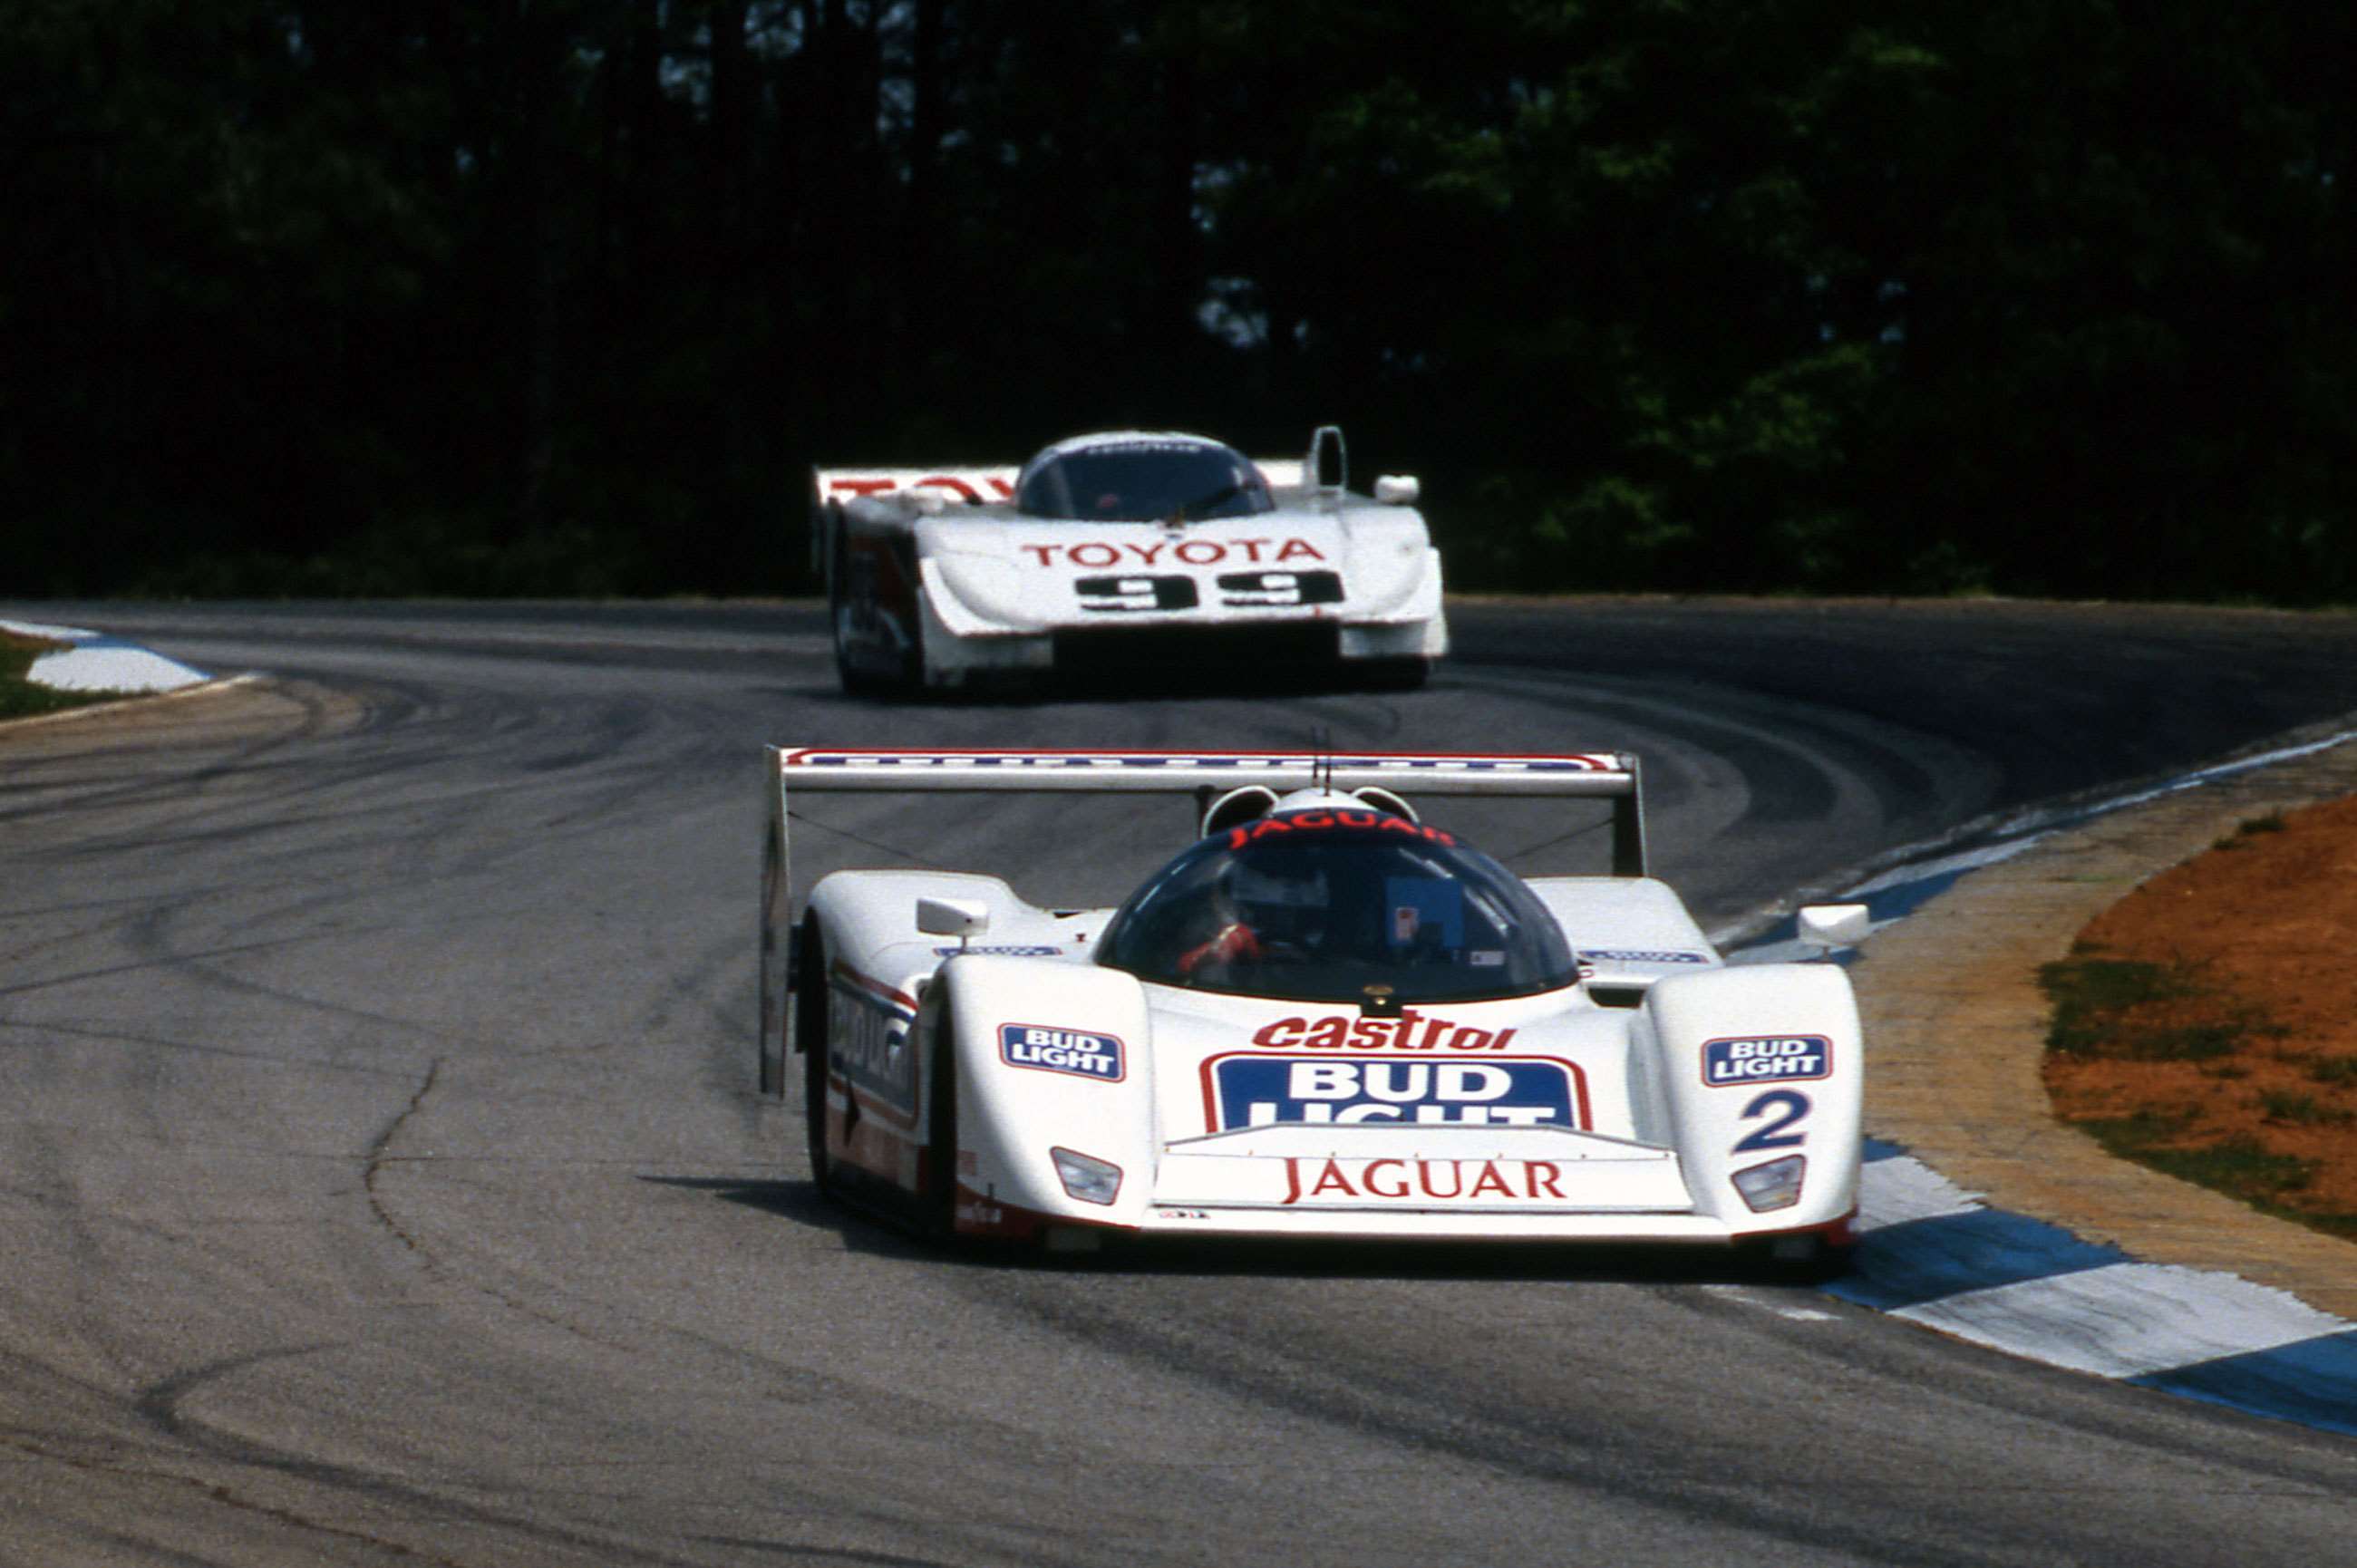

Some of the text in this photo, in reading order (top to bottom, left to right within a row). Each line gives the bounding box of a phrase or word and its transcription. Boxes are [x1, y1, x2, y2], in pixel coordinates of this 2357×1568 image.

[1021, 538, 1325, 567] TOYOTA
[1229, 810, 1455, 849] JAGUAR
[1025, 1029, 1101, 1053] BUD
[1730, 1040, 1808, 1060] BUD
[1012, 1042, 1115, 1073] LIGHT
[1713, 1055, 1821, 1079] LIGHT
[1289, 1062, 1513, 1102] BUD
[1730, 1088, 1813, 1157] 2
[1280, 1157, 1567, 1205] JAGUAR
